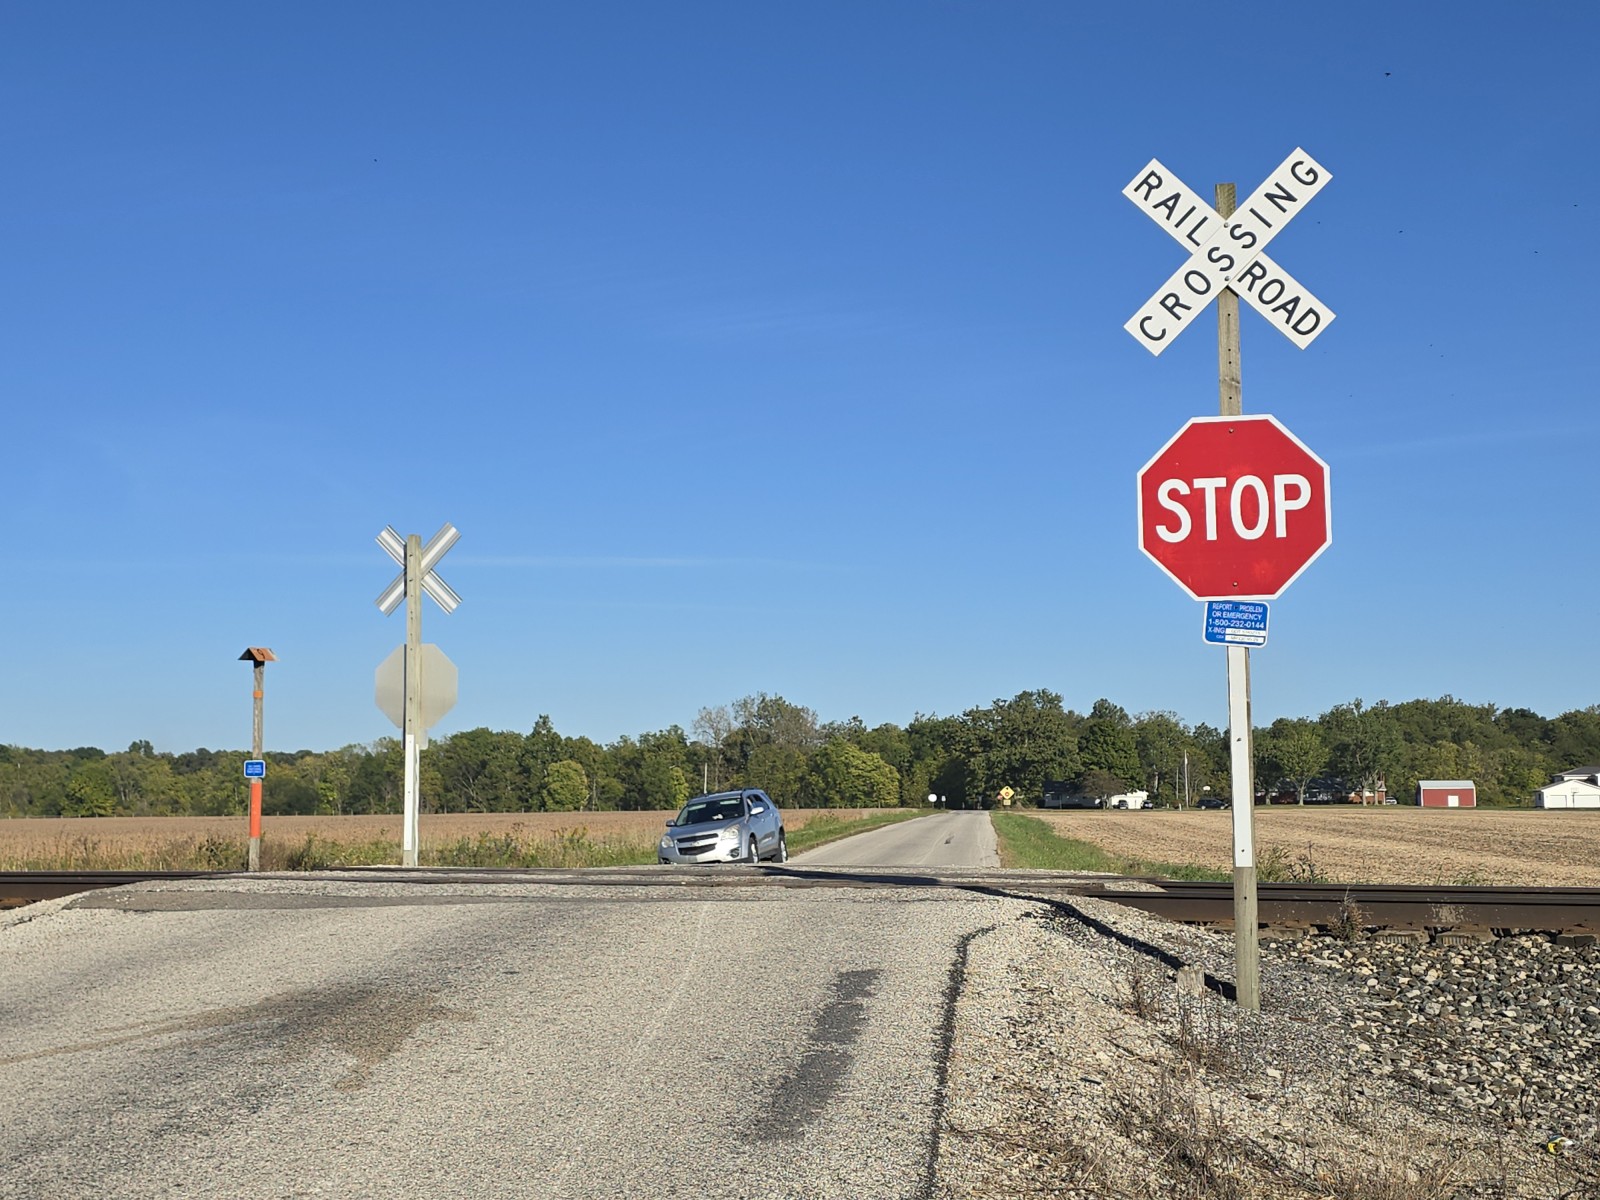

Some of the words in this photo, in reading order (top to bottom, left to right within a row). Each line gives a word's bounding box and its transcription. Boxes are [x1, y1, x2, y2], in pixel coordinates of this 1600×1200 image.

[1133, 170, 1209, 247] RAIL
[1237, 260, 1321, 336] ROAD
[1139, 160, 1319, 341] CROSSING
[1155, 474, 1312, 543] STOP
[1208, 618, 1264, 628] 1-800-232-0144
[1212, 602, 1232, 610] REPORT
[1239, 604, 1263, 612] PROBLEM
[1222, 611, 1262, 620] EMERGENCY
